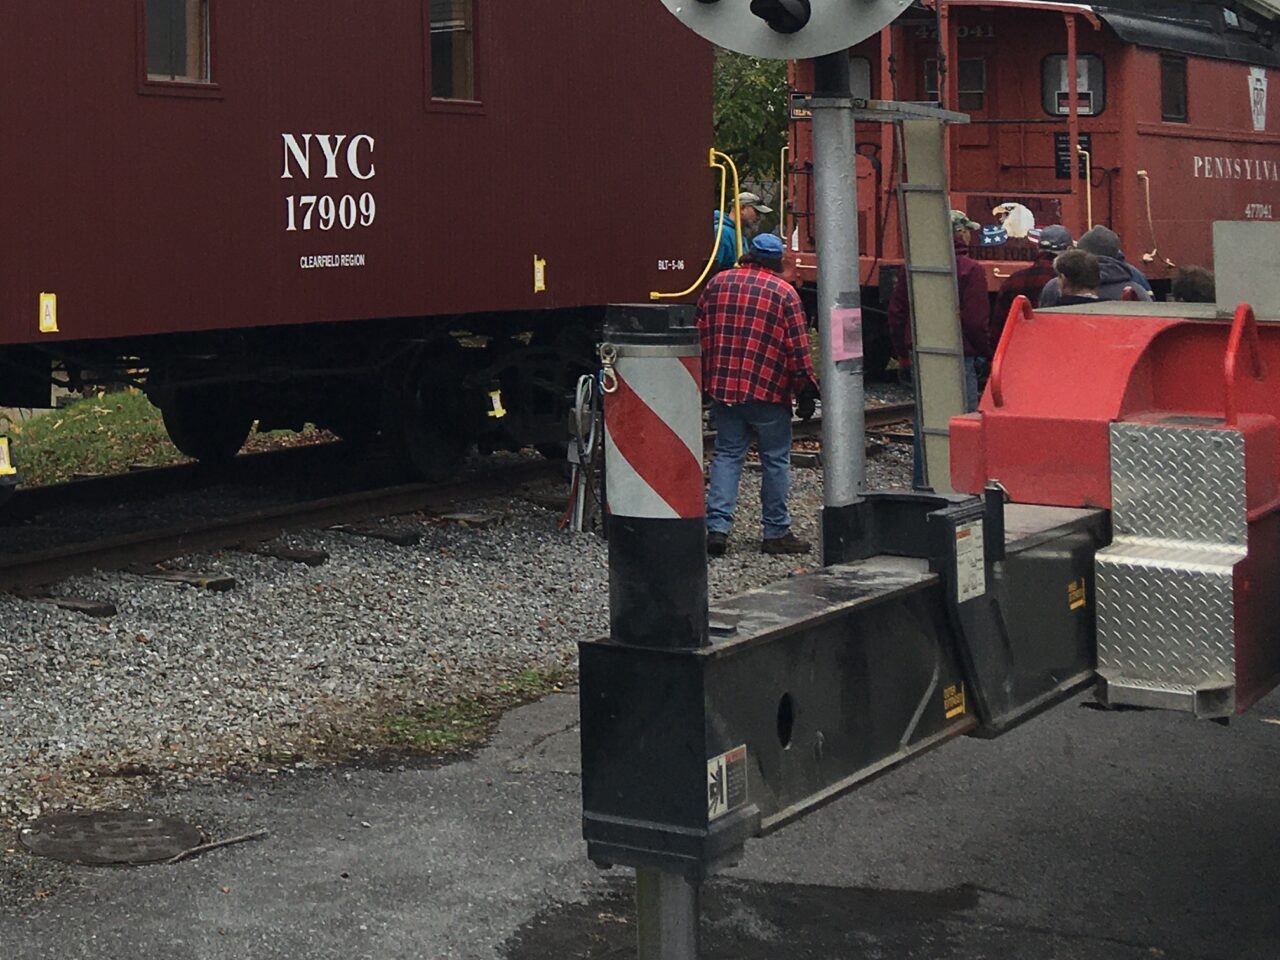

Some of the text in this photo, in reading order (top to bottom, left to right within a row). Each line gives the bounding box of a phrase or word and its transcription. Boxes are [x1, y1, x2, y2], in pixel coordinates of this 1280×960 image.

[280, 133, 376, 180] NYC
[285, 191, 376, 231] 17909
[300, 253, 366, 269] CLEARFIELD REGION
